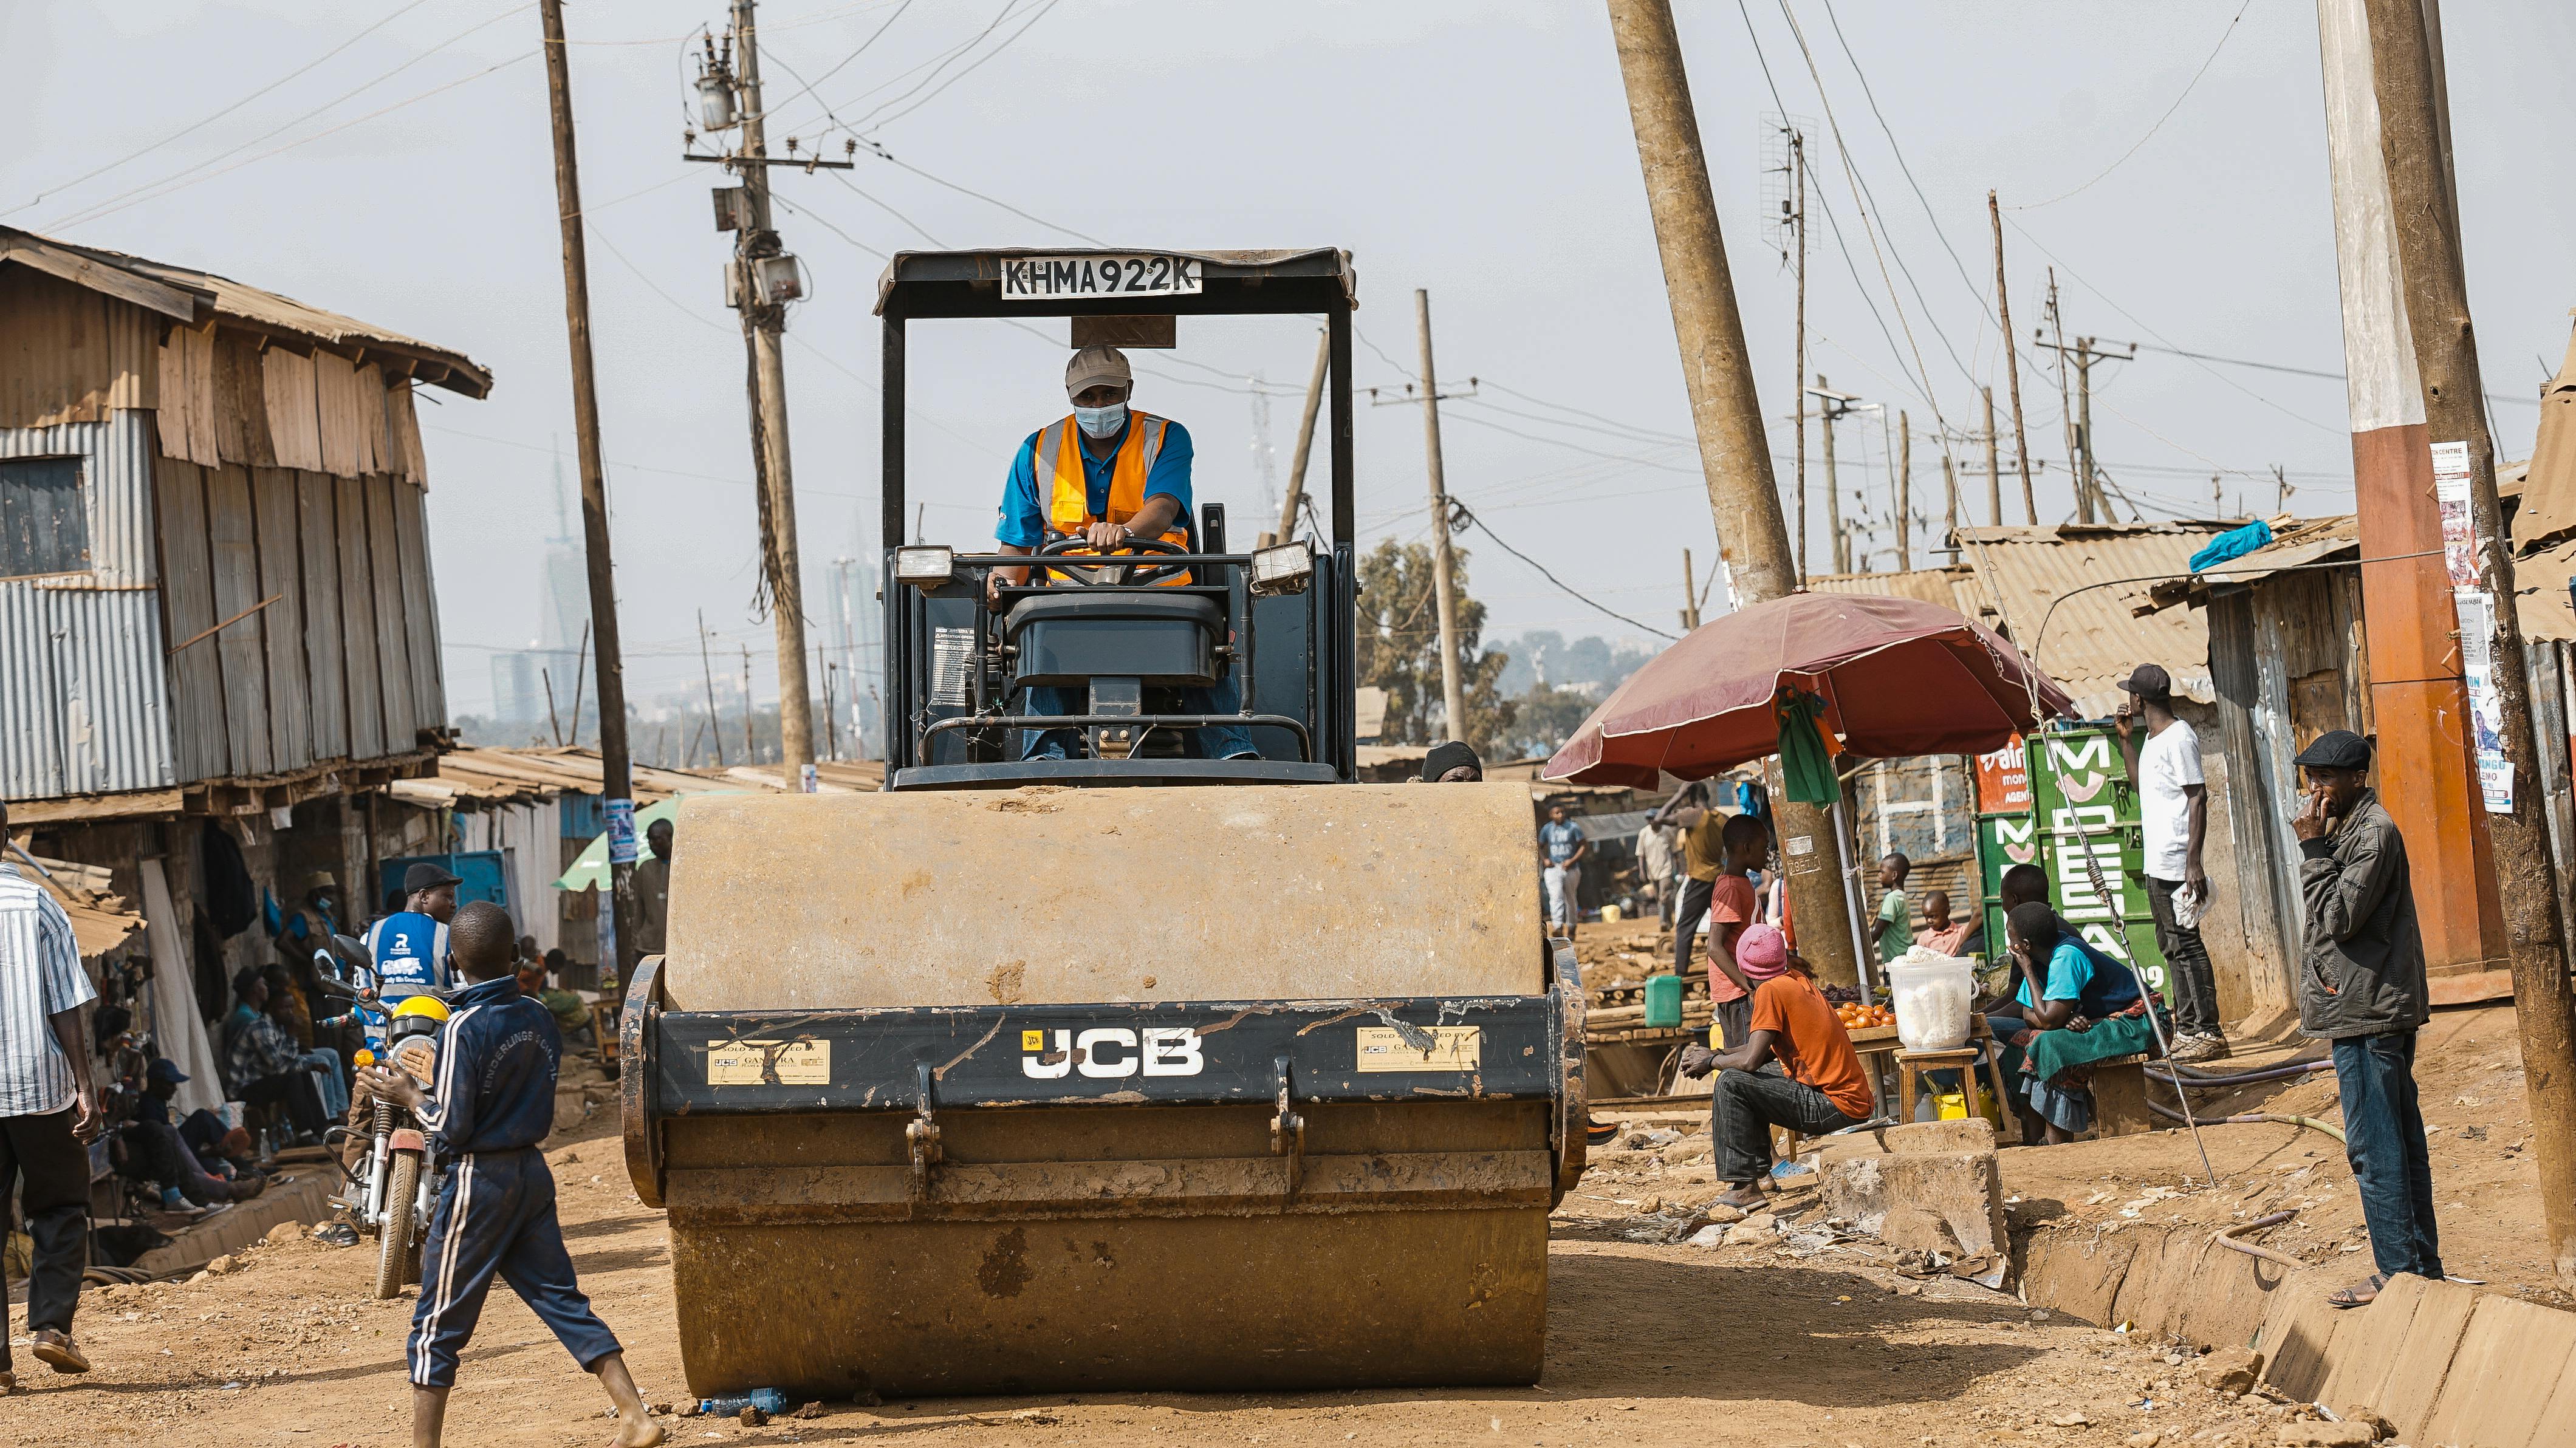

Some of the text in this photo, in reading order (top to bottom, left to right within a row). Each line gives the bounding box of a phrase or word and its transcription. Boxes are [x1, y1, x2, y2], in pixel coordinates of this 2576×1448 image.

[1005, 257, 1194, 295] KHMA922K
[1996, 742, 2025, 770] air
[2002, 774, 2027, 786] mon
[1022, 1028, 1204, 1079] JCB
